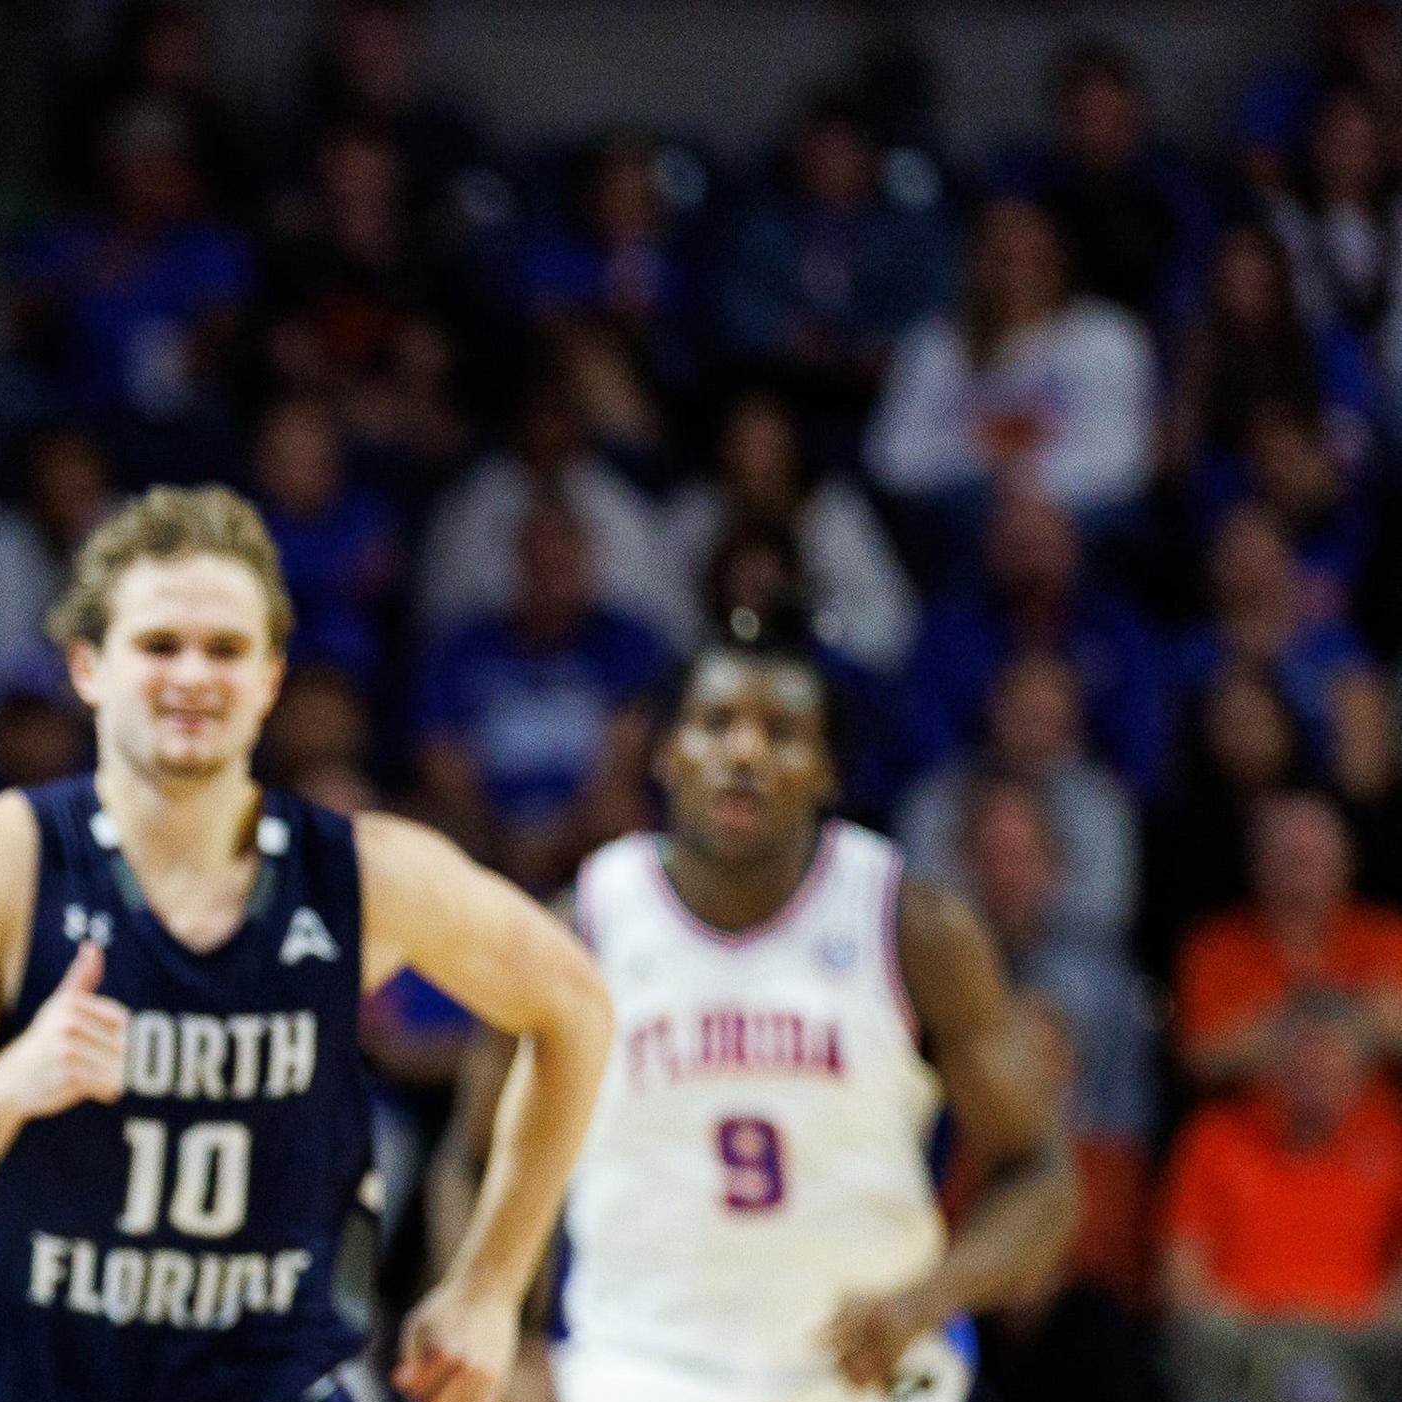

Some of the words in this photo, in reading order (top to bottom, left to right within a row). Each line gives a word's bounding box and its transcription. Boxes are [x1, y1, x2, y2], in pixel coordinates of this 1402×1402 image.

[125, 1008, 318, 1100] ORTH
[115, 1115, 253, 1239] 10
[710, 1114, 787, 1211] 9
